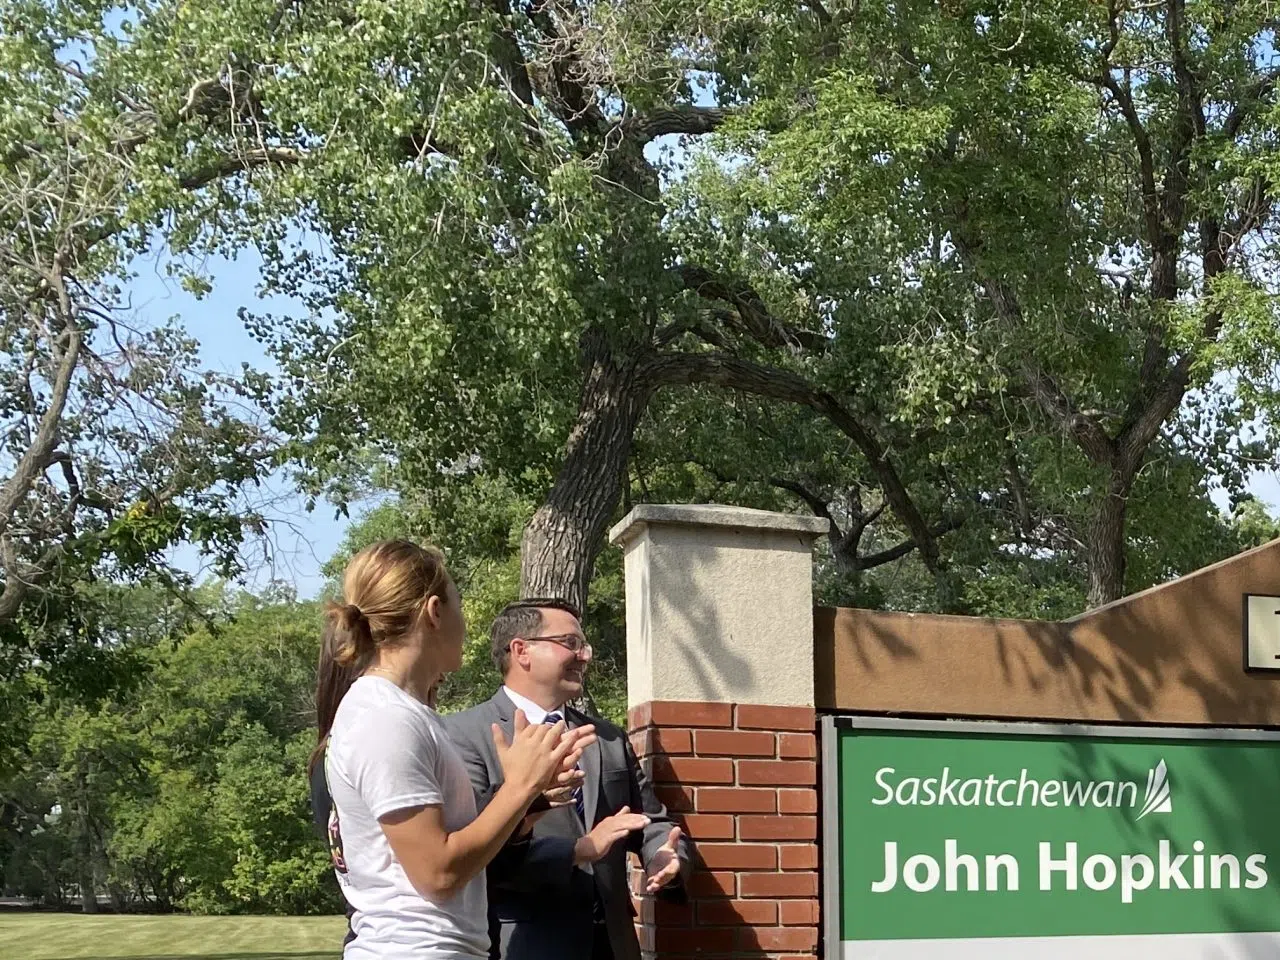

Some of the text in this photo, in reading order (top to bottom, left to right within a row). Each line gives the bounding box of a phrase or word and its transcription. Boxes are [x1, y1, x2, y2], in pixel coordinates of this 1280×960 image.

[871, 766, 1138, 808] Saskatchewan
[871, 839, 1019, 893] John
[1039, 839, 1269, 903] Hopkins
